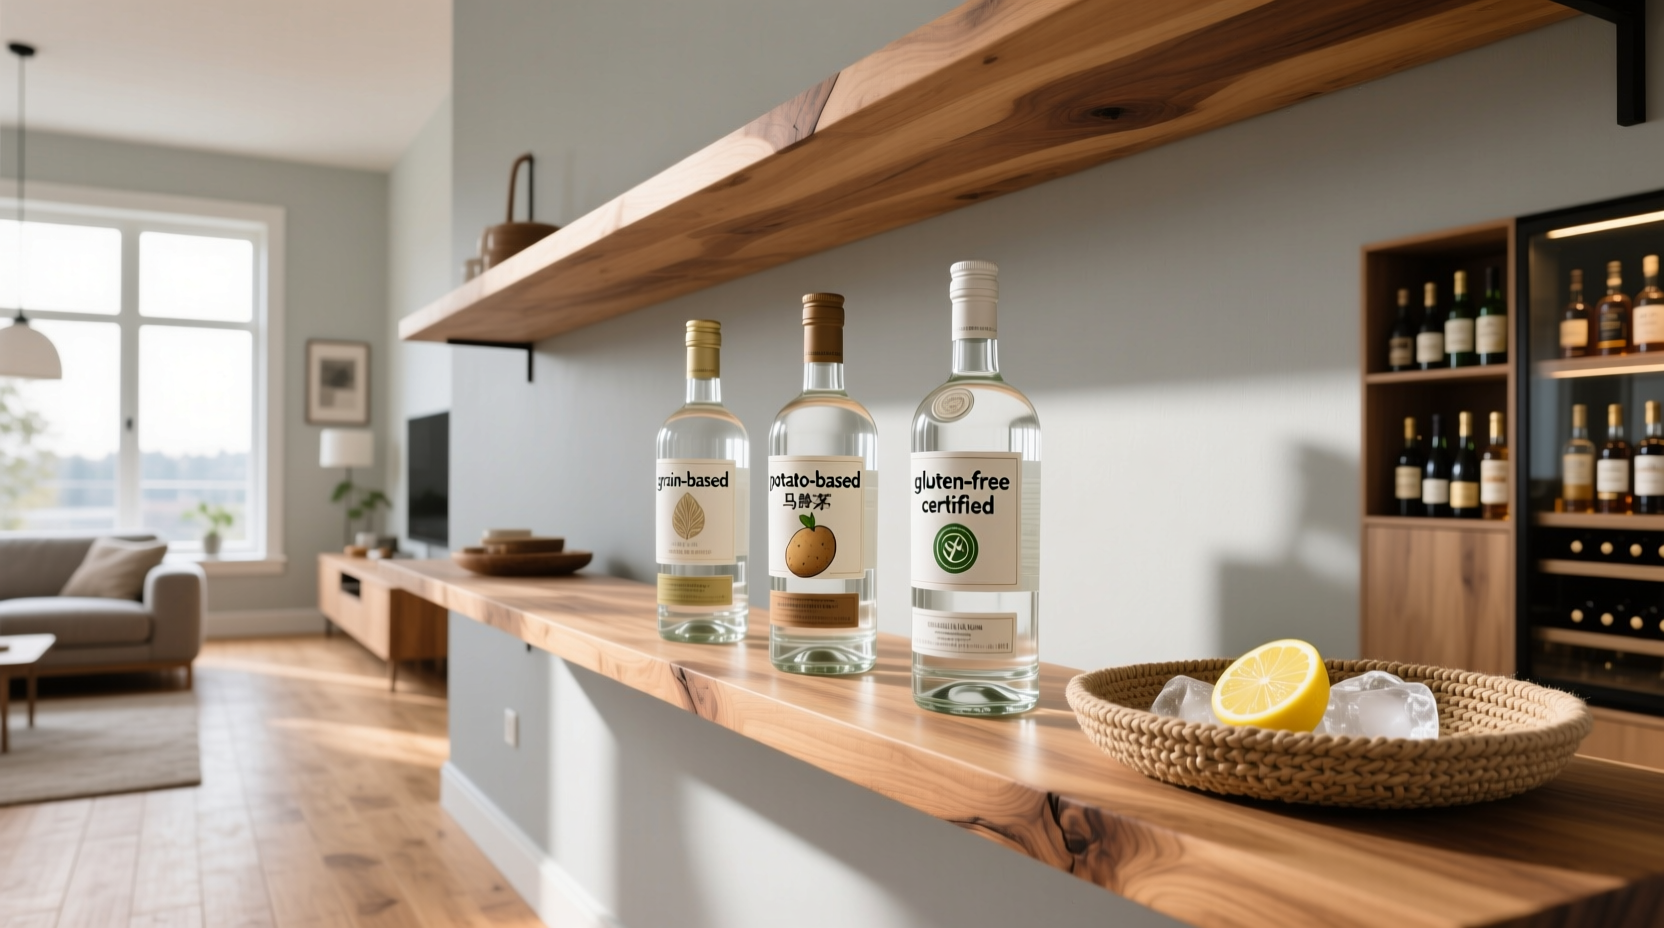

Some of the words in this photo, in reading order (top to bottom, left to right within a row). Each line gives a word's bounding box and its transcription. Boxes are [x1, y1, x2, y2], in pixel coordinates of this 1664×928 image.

[769, 469, 861, 492] potato-based
[914, 469, 1010, 495] gluten-free
[921, 494, 994, 515] certified
